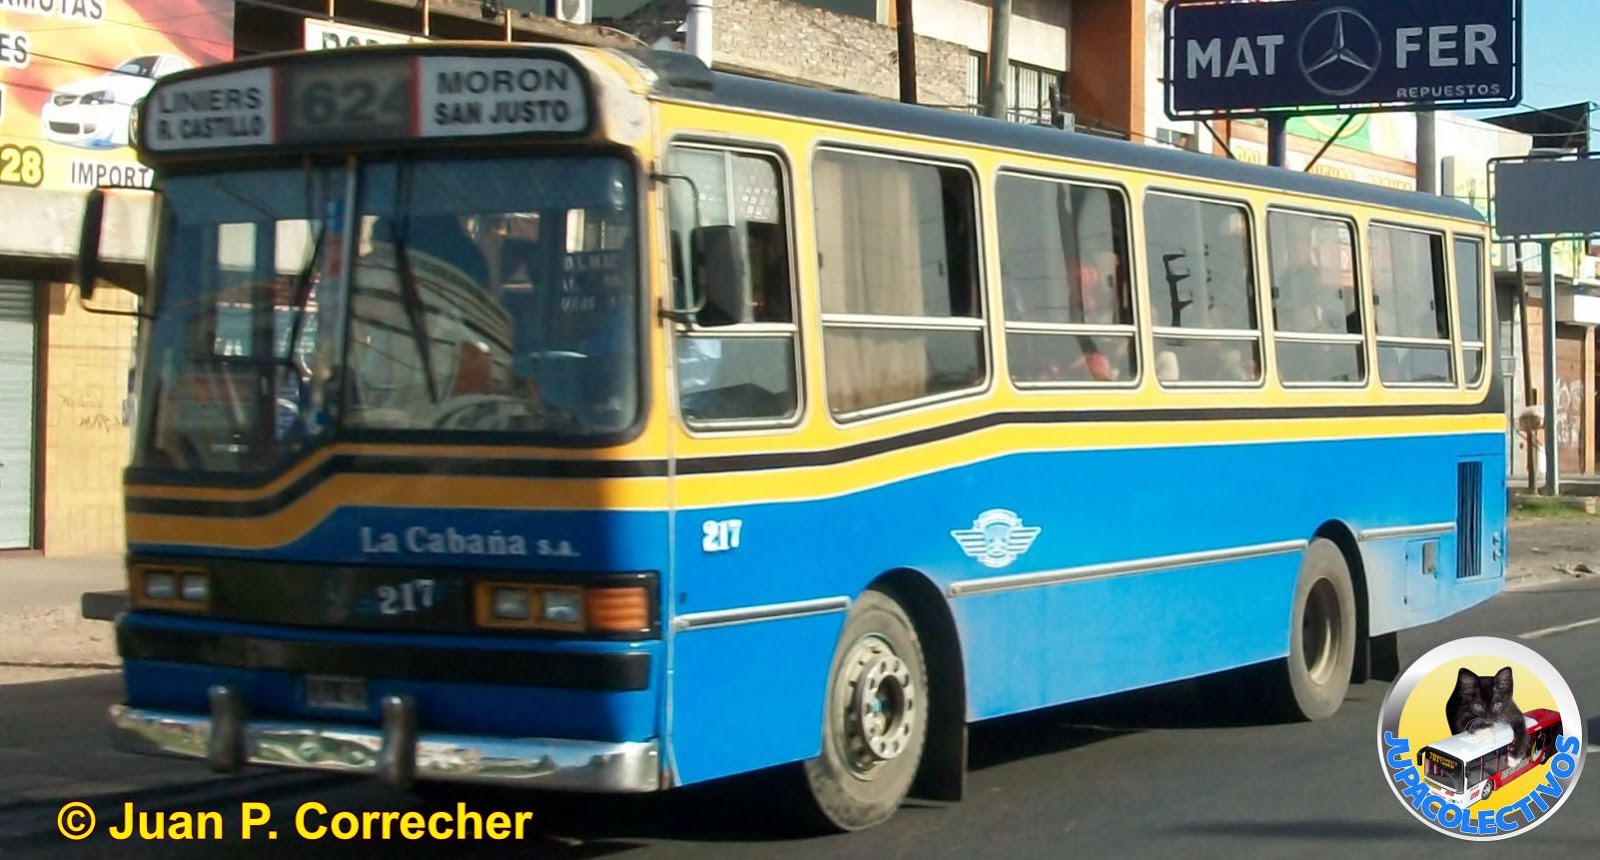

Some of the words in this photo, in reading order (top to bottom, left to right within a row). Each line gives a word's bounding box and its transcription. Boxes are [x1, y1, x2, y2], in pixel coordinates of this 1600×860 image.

[1186, 34, 1285, 80] MAT
[1395, 23, 1499, 69] FER
[436, 68, 569, 95] MORON
[1396, 83, 1501, 99] REPUESTOS
[158, 87, 262, 114] LINIERS
[434, 102, 482, 125] SAN
[489, 100, 569, 123] JUSTO
[358, 525, 399, 554] La
[702, 518, 743, 553] 217
[376, 578, 436, 616] 217
